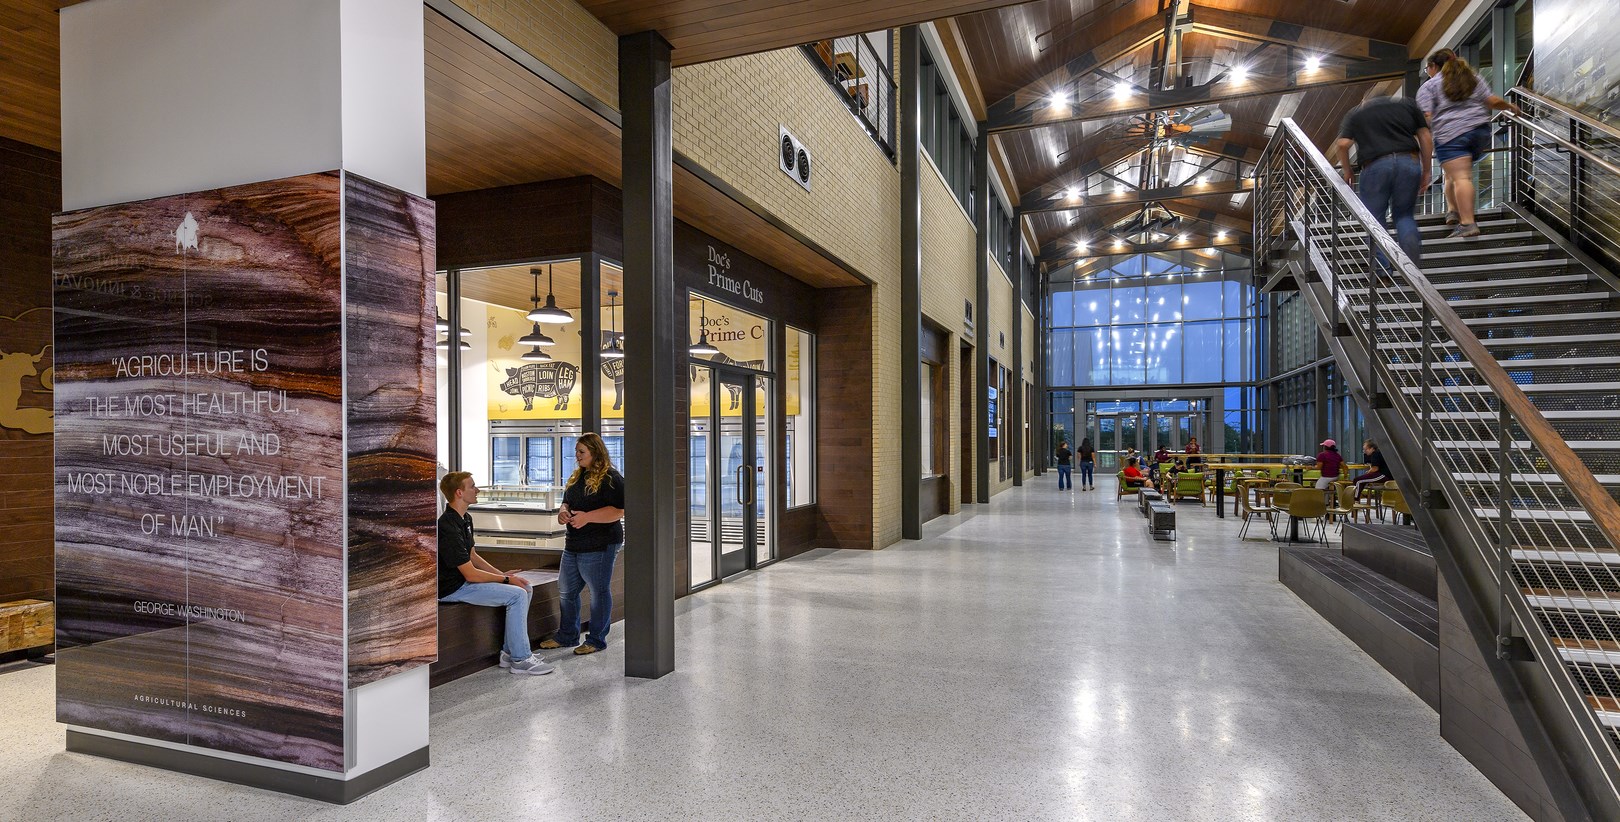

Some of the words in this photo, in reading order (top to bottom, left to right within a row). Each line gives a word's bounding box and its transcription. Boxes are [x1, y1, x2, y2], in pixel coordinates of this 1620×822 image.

[708, 245, 731, 270] Doc's
[708, 264, 741, 295] Prime
[743, 280, 764, 304] Cuts
[251, 348, 268, 372] IS
[538, 370, 554, 380] LOIN
[558, 367, 574, 380] LEG
[558, 379, 573, 389] HAM
[86, 396, 119, 417] THE
[125, 394, 177, 417] MOST
[182, 390, 299, 417] HEALTHFUL,
[103, 435, 153, 456] MOST
[159, 434, 231, 456] USEFUL
[236, 433, 281, 456] AND
[68, 473, 116, 494] MOST
[122, 473, 182, 496] NOBLE
[188, 475, 326, 499] EMPLOYMENT
[140, 513, 165, 535] OF
[134, 600, 175, 616] GEORGE
[177, 604, 245, 622] WASHINGTON
[134, 694, 198, 710] AGRICULTURAL
[202, 704, 246, 718] SCIENCES
